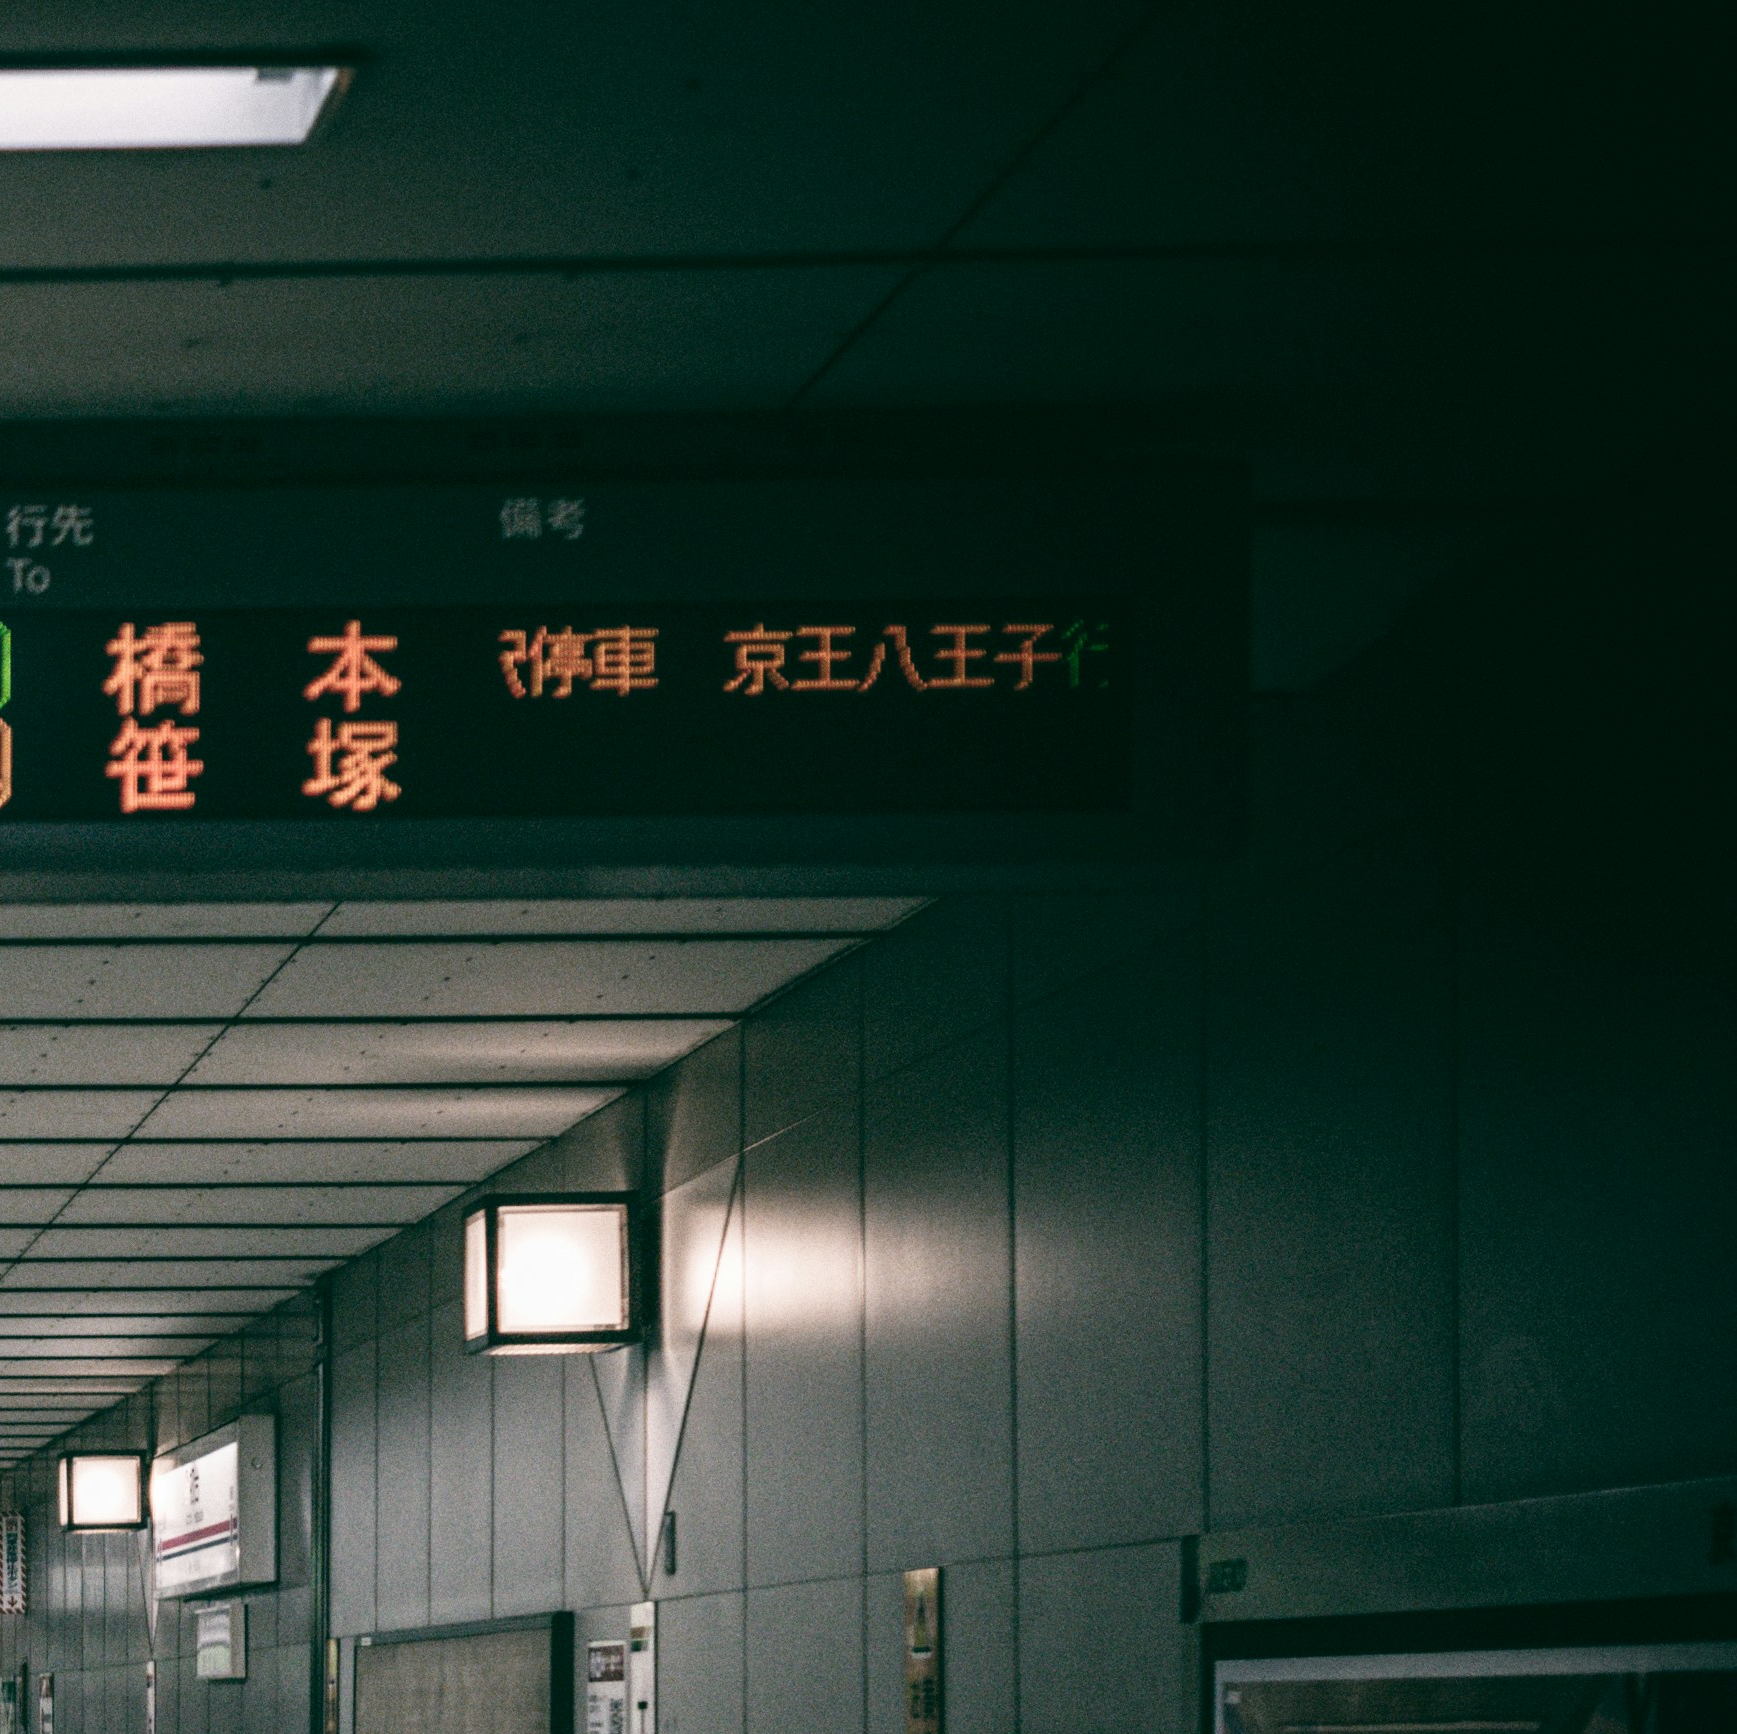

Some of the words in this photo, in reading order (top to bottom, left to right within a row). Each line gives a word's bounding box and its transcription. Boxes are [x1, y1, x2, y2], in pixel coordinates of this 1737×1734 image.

[3, 502, 95, 548] 行先
[498, 497, 586, 541] 備考
[3, 556, 52, 595] To
